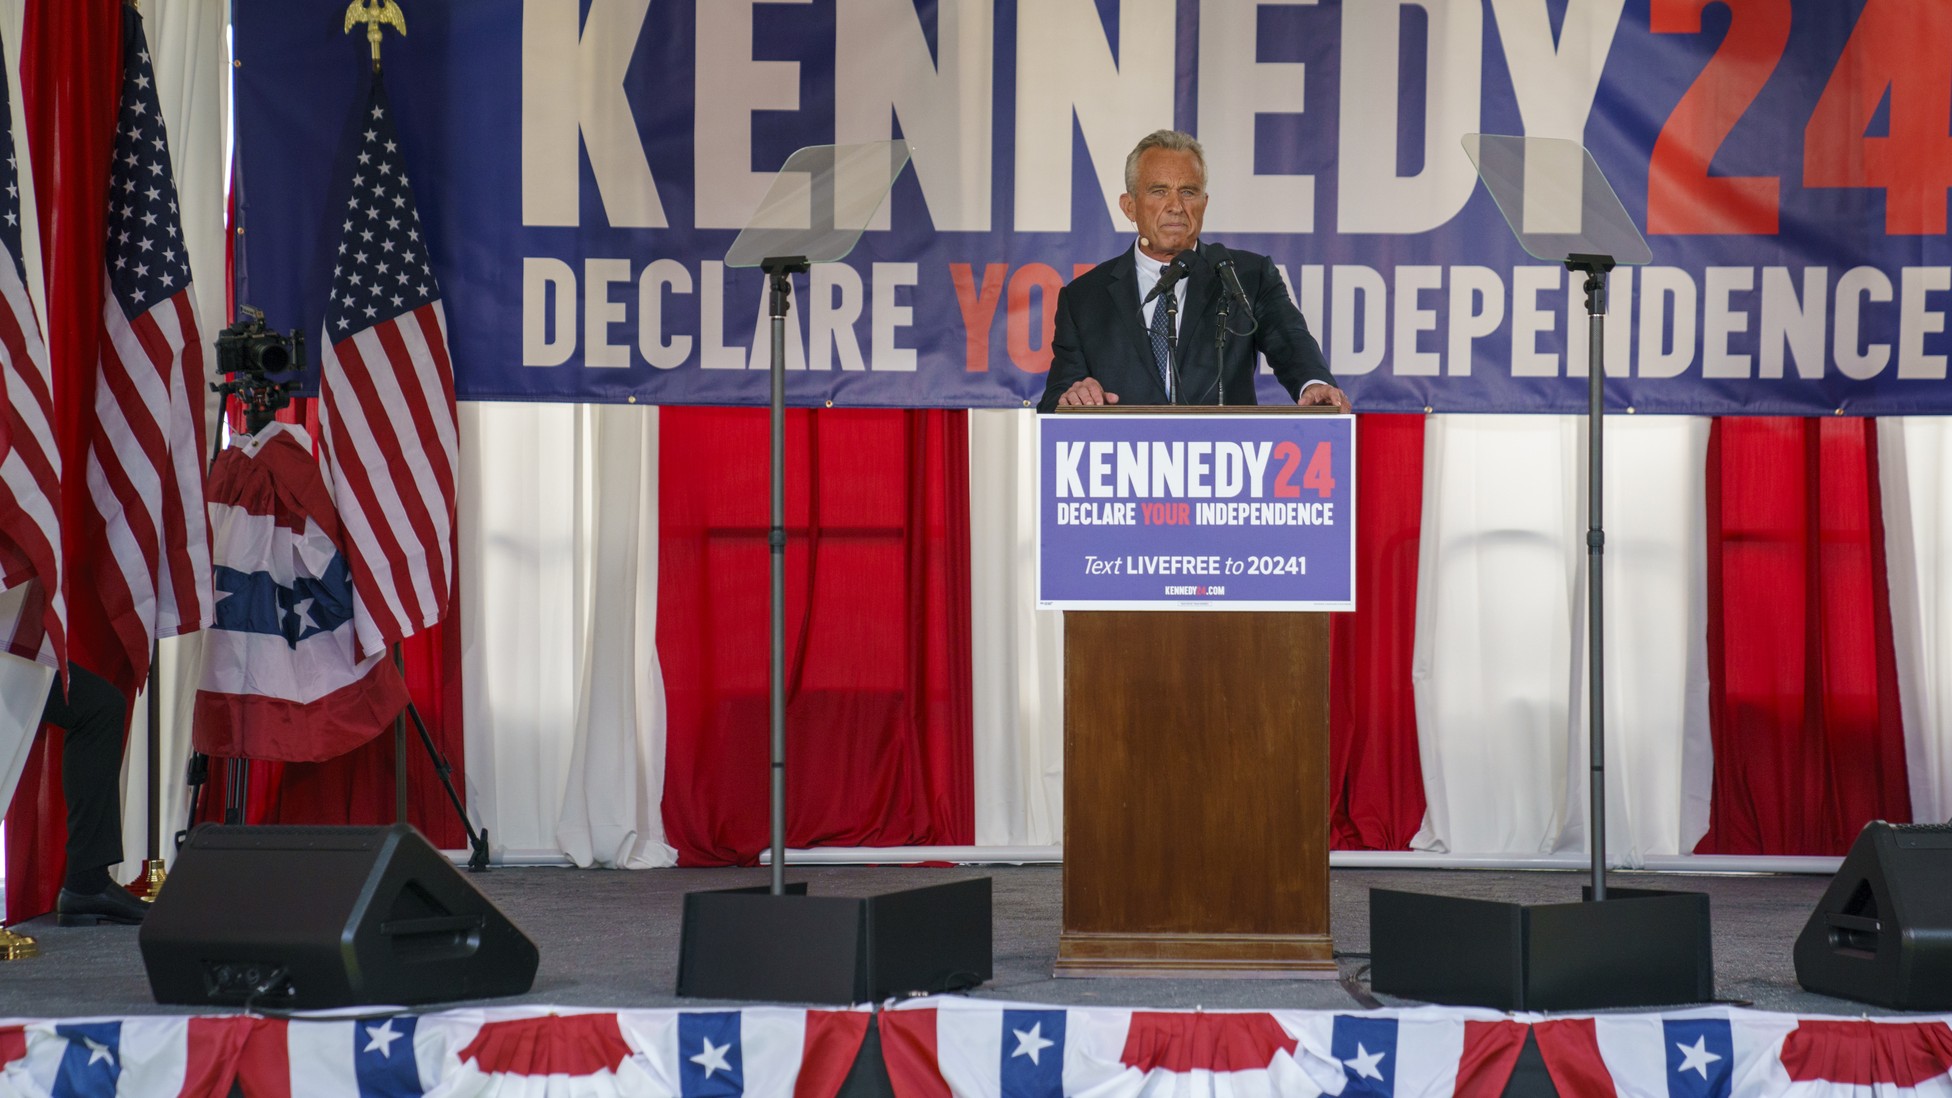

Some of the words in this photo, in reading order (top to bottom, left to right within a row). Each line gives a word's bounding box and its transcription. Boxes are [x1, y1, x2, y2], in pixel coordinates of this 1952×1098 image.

[522, 0, 1952, 235] KENNEDY24
[522, 257, 917, 372] DECLARE
[949, 262, 1098, 374] YO
[1055, 441, 1336, 498] KENNEDY24
[1057, 502, 1136, 526] DECLARE
[1141, 502, 1190, 526] YOUR
[1195, 502, 1334, 526] INDEPENDENCE
[1084, 556, 1122, 575] Text
[1126, 556, 1221, 575] LIVEFREE
[1224, 557, 1244, 575] to
[1247, 556, 1307, 575] 20241
